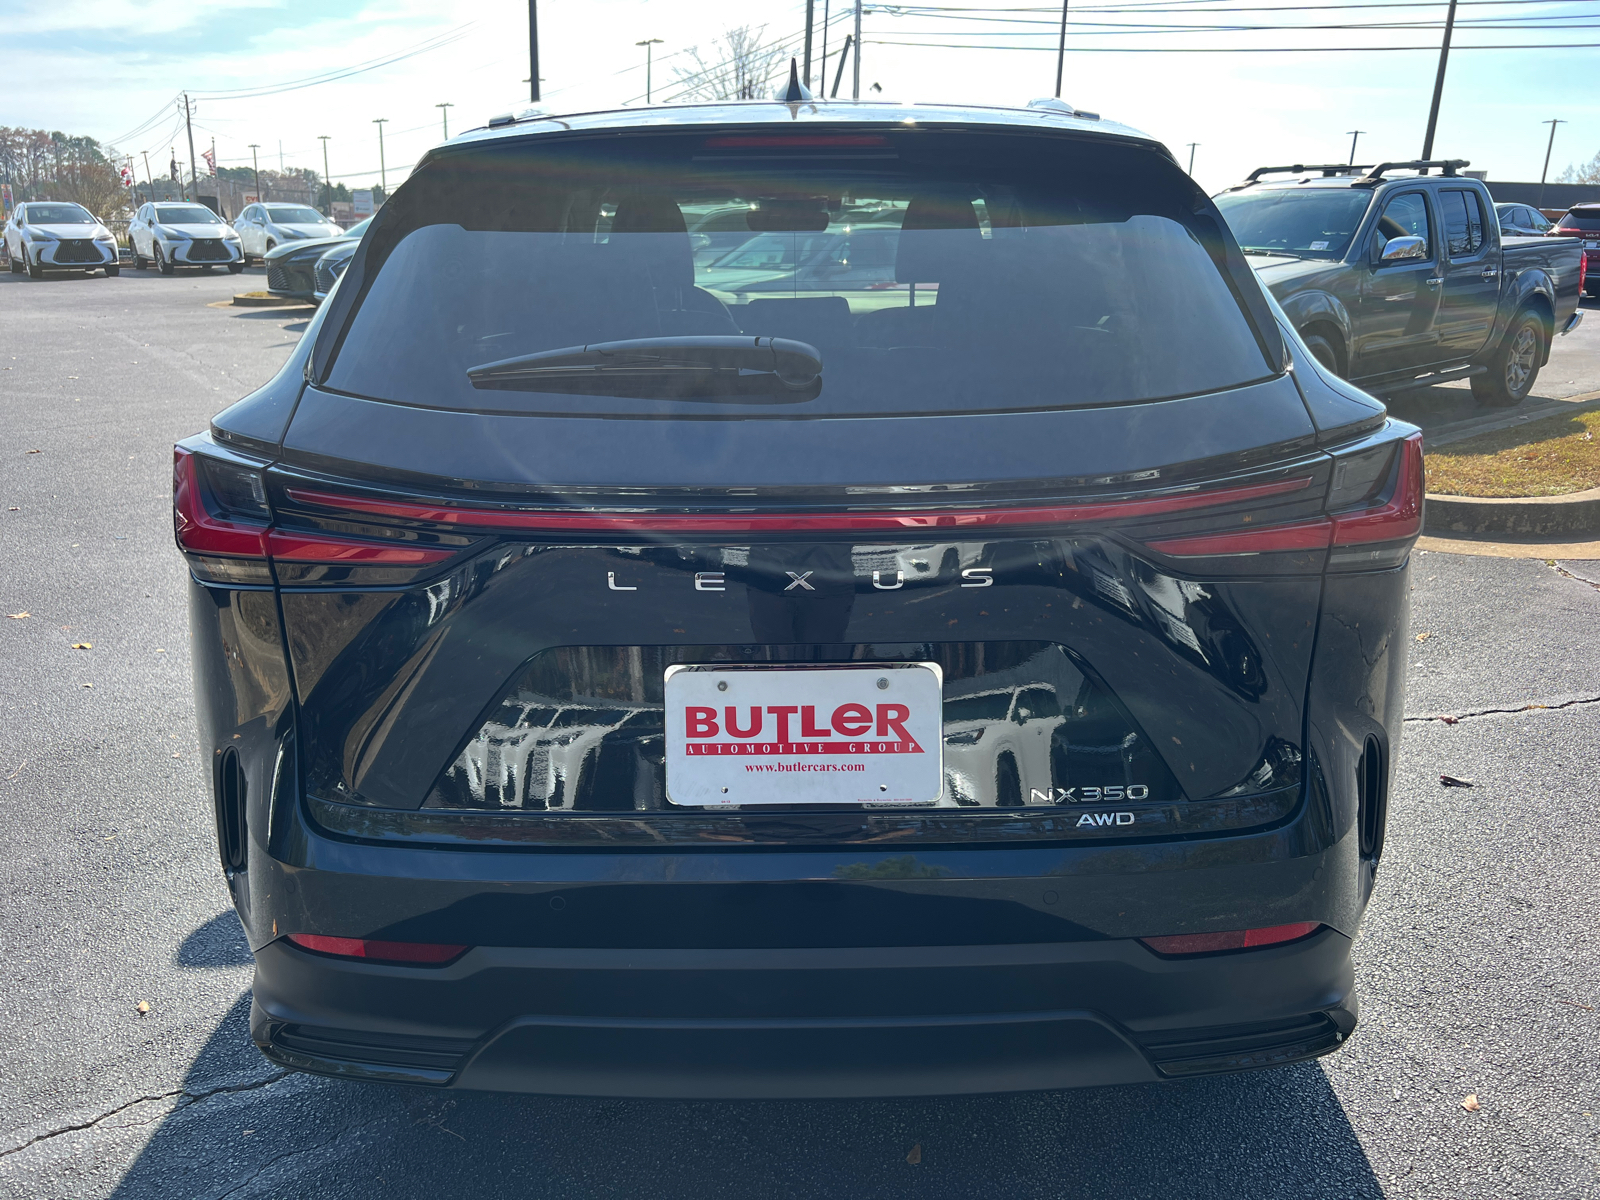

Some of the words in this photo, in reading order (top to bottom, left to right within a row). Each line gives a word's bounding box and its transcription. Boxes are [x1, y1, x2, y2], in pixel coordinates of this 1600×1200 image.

[607, 568, 994, 591] LEXUS
[687, 743, 825, 754] AUTOMOTIVE
[848, 742, 916, 753] GROUP
[745, 762, 866, 773] www.butlercars.com
[1030, 784, 1149, 803] NX350
[1075, 812, 1136, 828] AWD
